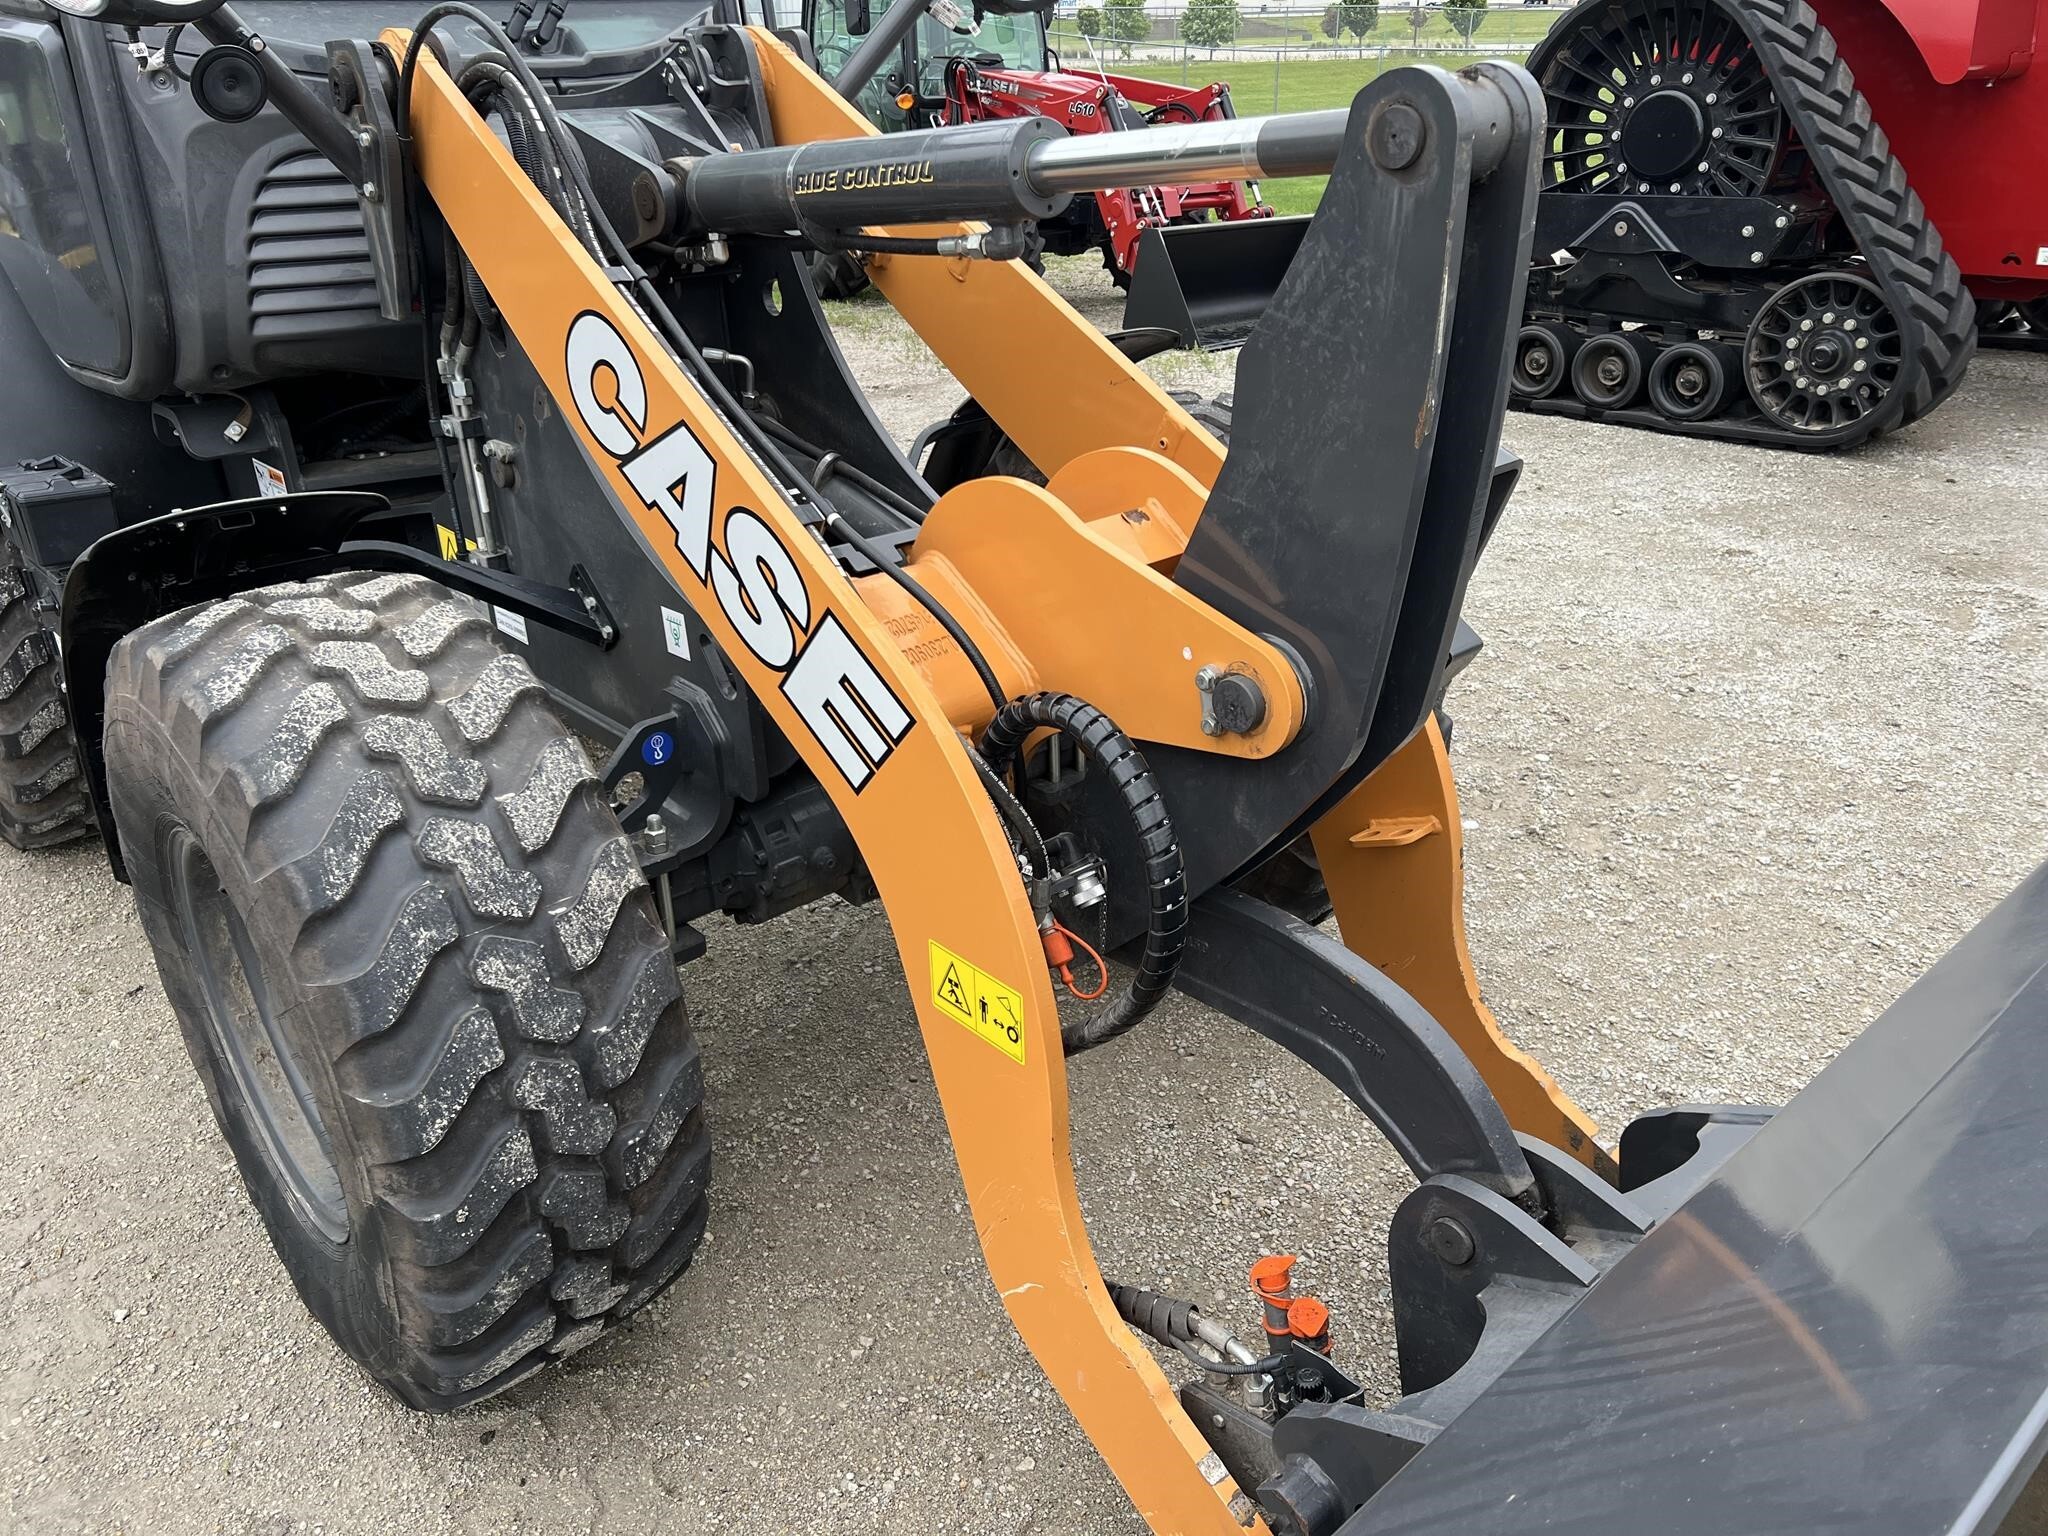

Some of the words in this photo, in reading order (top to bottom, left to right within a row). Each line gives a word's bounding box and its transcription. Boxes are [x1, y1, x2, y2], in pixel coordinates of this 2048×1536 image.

[979, 77, 1009, 93] CASE
[1068, 101, 1095, 117] L610
[794, 169, 838, 194] RIDE
[842, 160, 934, 190] CONTROL
[565, 309, 916, 795] CASE
